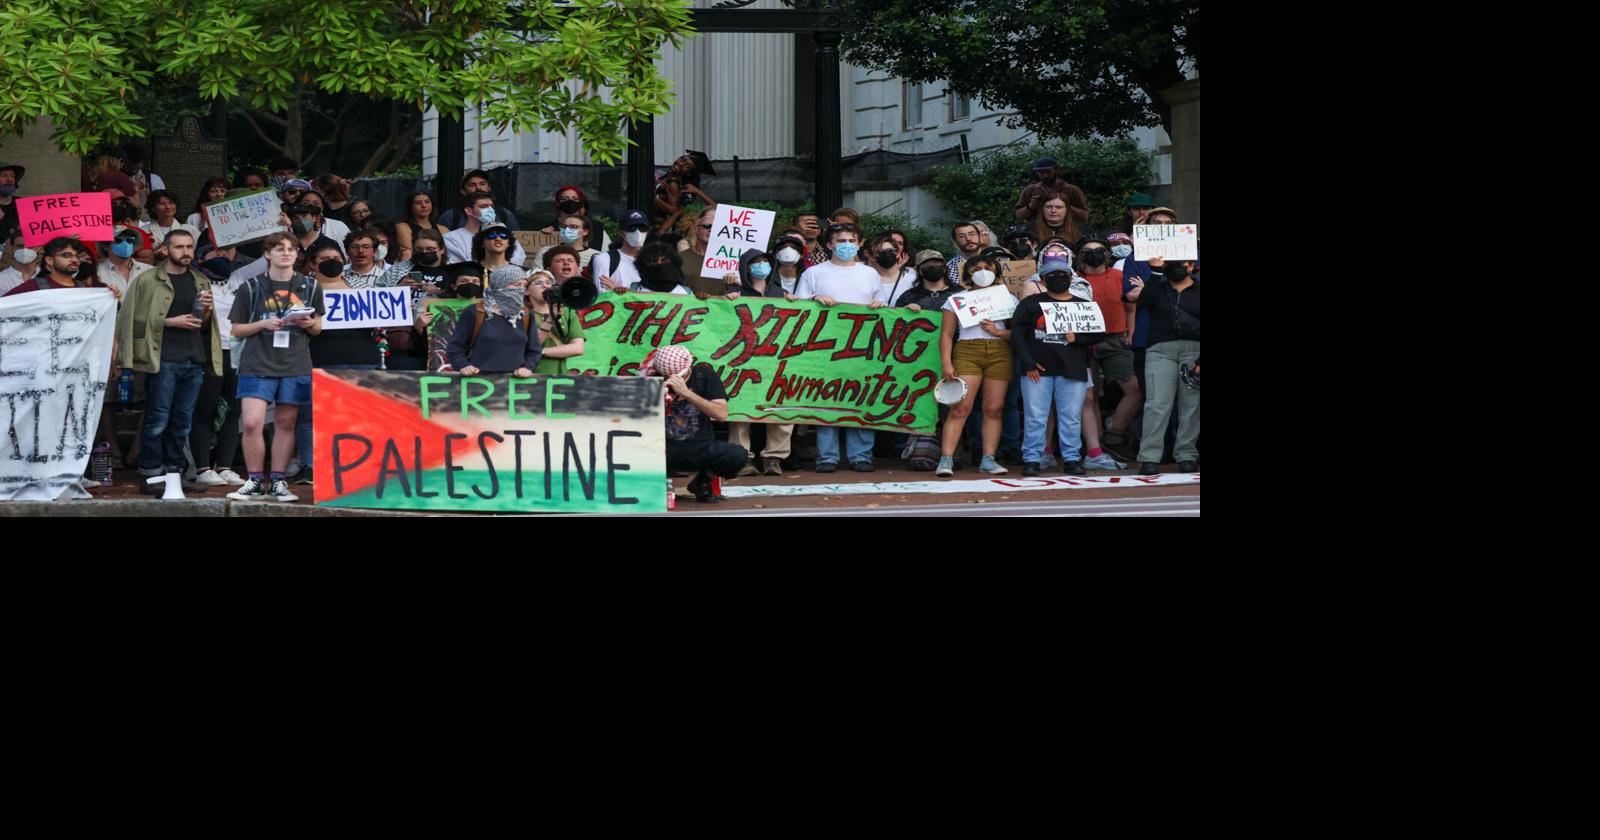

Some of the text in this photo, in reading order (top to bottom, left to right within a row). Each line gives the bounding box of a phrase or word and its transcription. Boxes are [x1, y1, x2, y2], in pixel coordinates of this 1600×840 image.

[33, 196, 80, 212] FREE
[211, 193, 272, 217] FROM THE RIVER
[29, 214, 112, 235] PALESTINE
[218, 213, 230, 224] TO
[233, 210, 250, 221] THE
[729, 208, 756, 226] WE
[717, 225, 758, 242] ARE
[325, 289, 407, 321] ZIONISM
[1052, 302, 1094, 313] By The
[1055, 312, 1096, 322] Millions
[1076, 321, 1102, 331] Return
[616, 301, 709, 347] THE
[711, 303, 939, 368] KILLING
[419, 376, 576, 420] FREE
[766, 359, 939, 425] humanity?
[332, 430, 642, 504] PALESTINE
